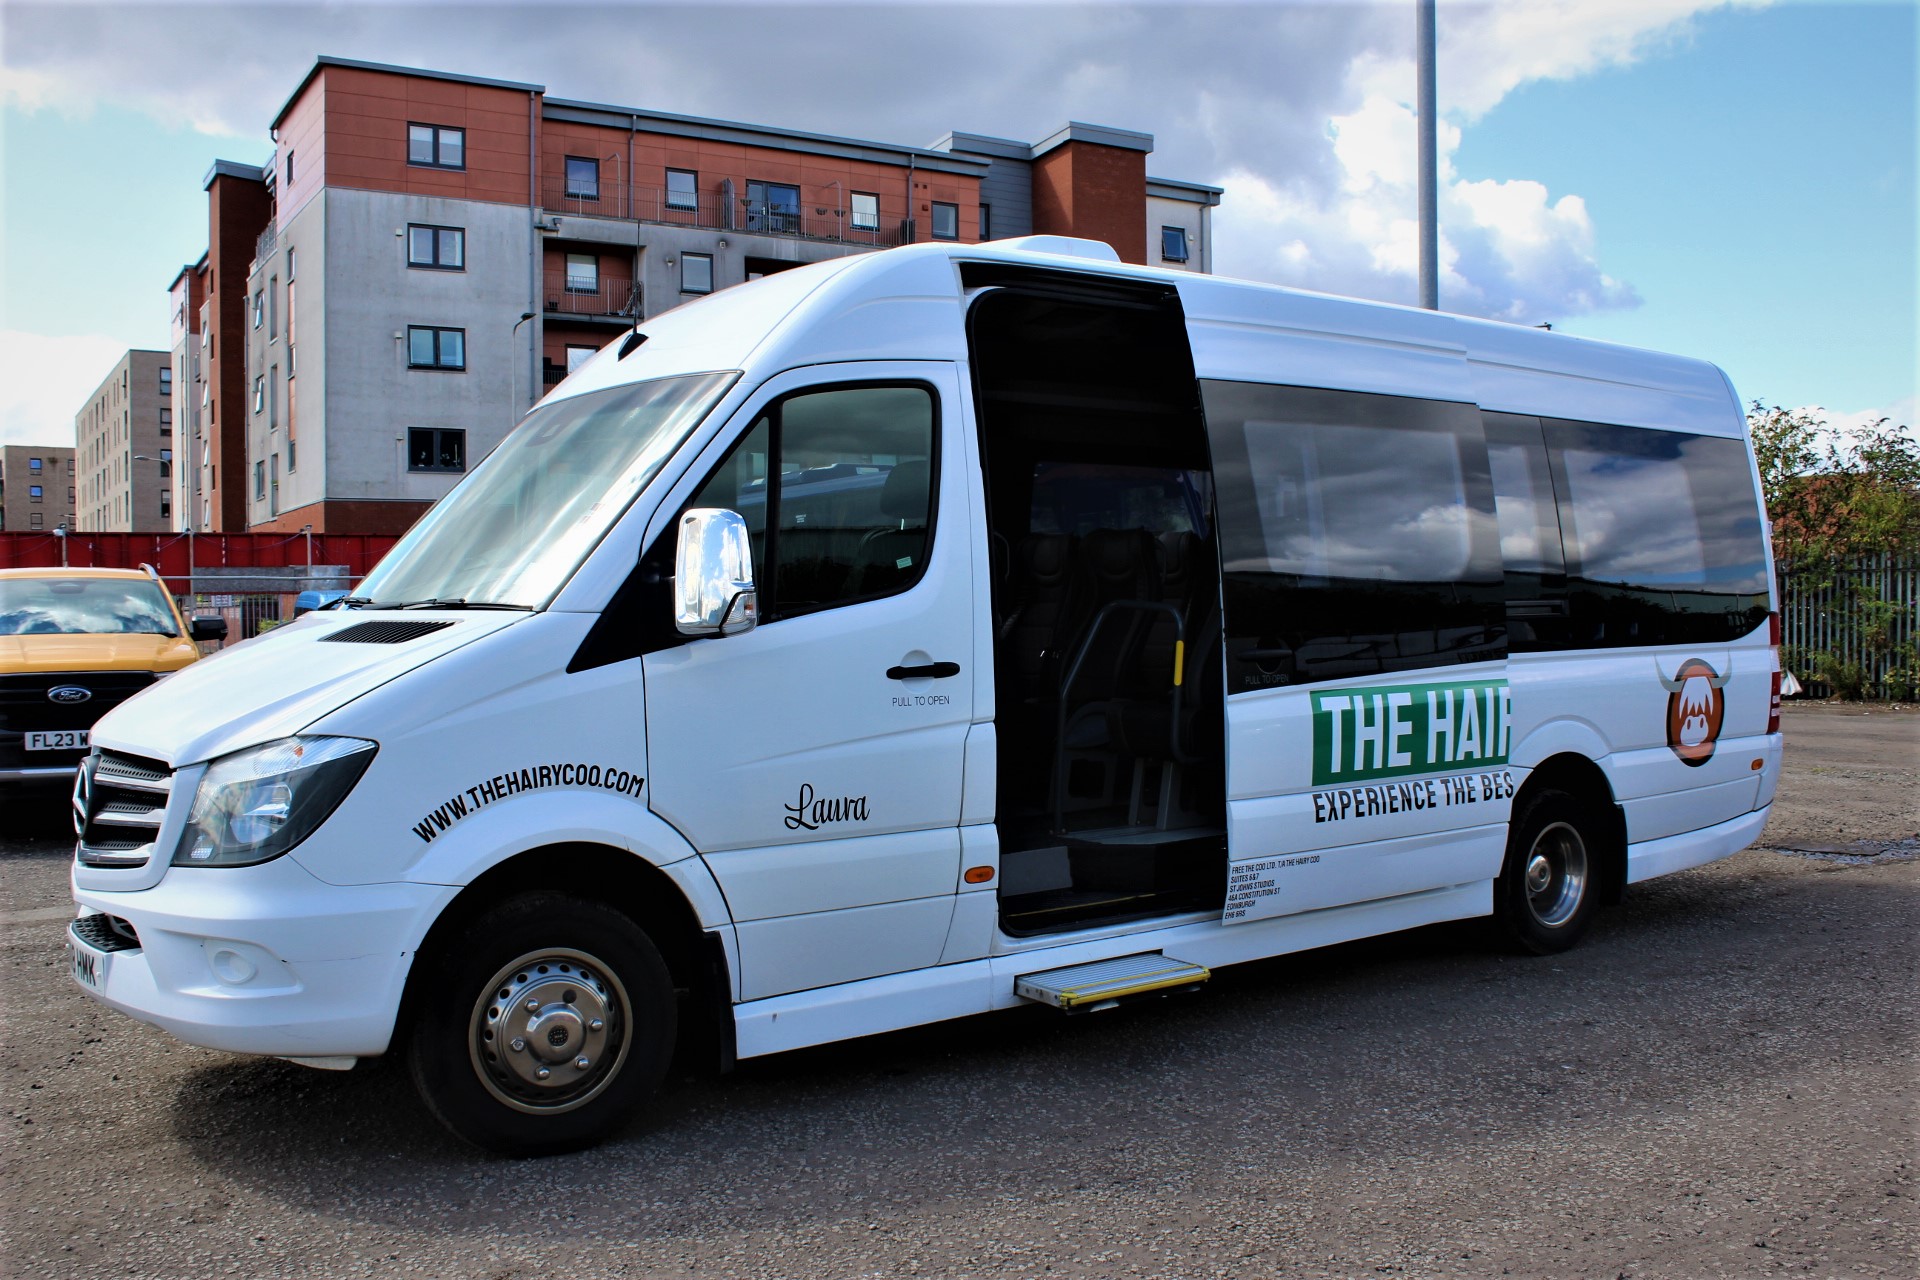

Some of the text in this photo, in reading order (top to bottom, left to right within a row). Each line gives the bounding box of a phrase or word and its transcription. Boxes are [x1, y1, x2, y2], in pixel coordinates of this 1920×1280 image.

[1244, 673, 1289, 685] PULL TO OPEN
[58, 690, 82, 700] Ford
[892, 695, 950, 707] PULL TO OPEN
[1319, 692, 1413, 774] THE
[32, 733, 75, 748] FL23
[411, 763, 645, 844] WWW.THEHAIRYCOO.COM
[1311, 771, 1514, 823] EXPERIENCE THE BES
[784, 783, 871, 831] Laura
[1231, 866, 1244, 874] FREE
[1245, 865, 1254, 873] THE
[1255, 864, 1266, 872] COO
[1286, 859, 1295, 867] THE
[1295, 857, 1309, 866] HAIRY
[1309, 855, 1320, 864] COO
[1229, 879, 1275, 893] ST JOHNS STUDIOS
[1230, 874, 1249, 884] SUITES
[1238, 888, 1273, 900] CONSTITUTION
[1273, 887, 1280, 895] ST
[1226, 900, 1256, 911] EDINBURGH
